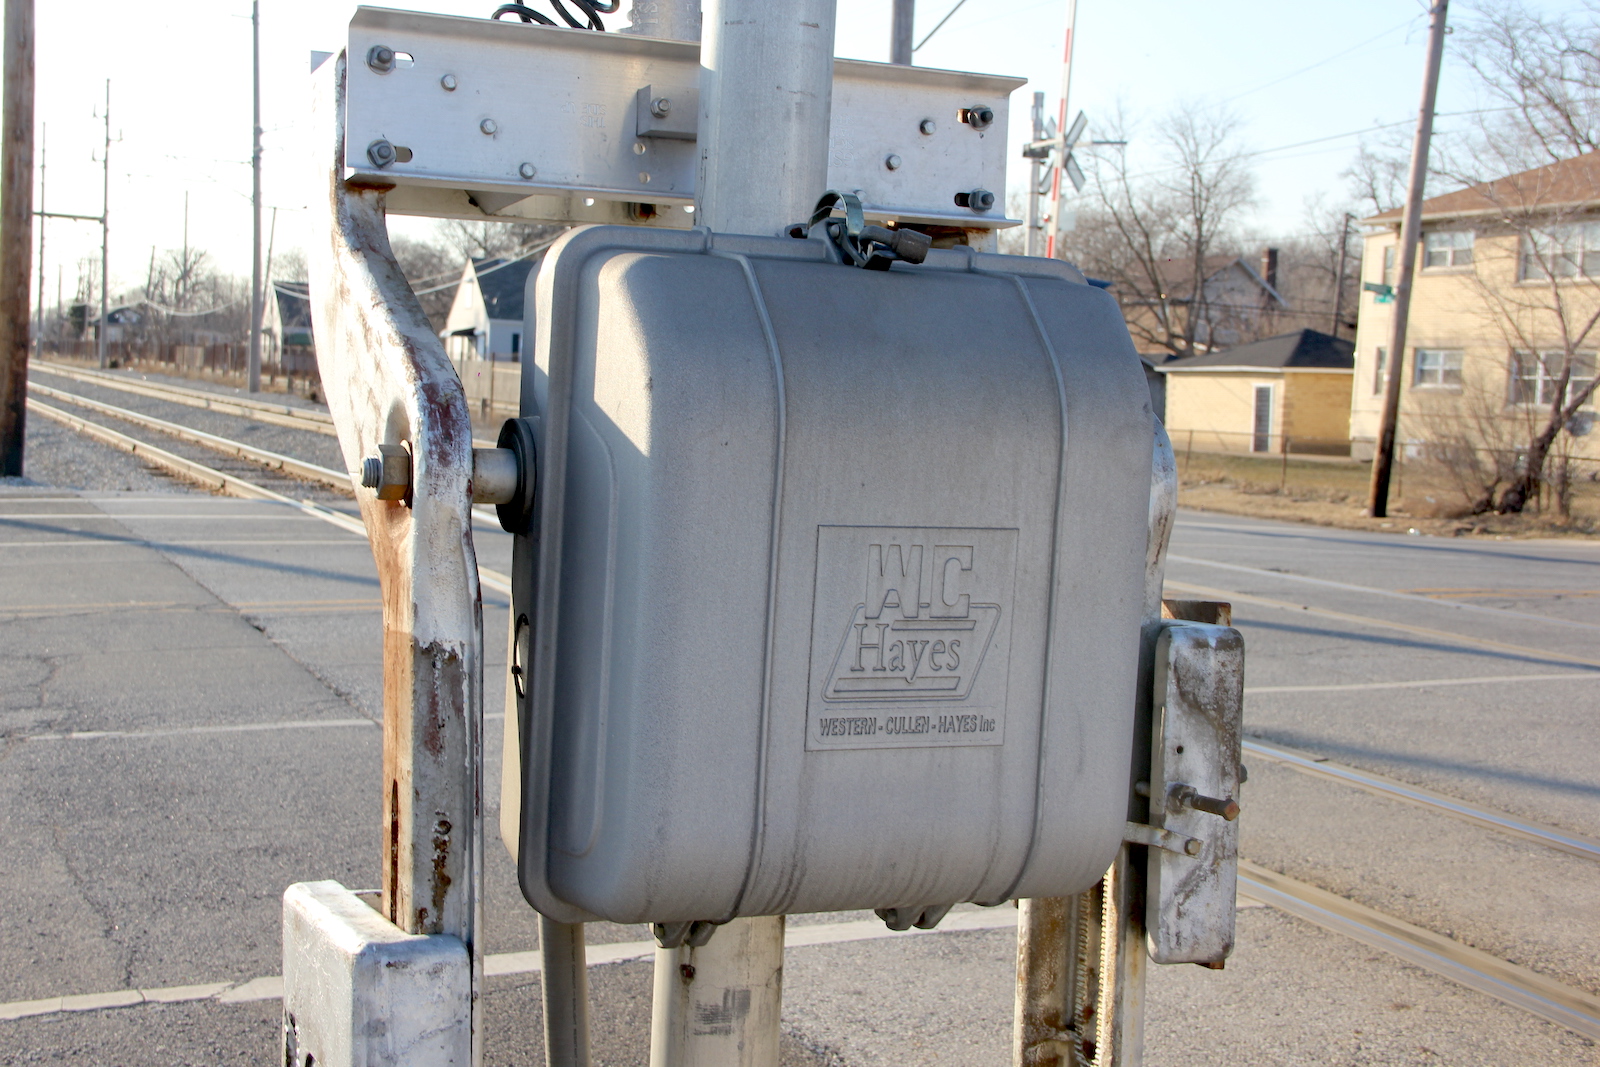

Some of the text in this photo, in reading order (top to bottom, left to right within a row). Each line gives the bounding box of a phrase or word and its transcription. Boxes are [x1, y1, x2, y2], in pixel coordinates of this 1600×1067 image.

[850, 623, 961, 682] Hayes
[819, 717, 877, 736] WESTERN
[885, 715, 930, 735] CULLEN
[938, 714, 978, 733] HAYES
[979, 714, 996, 732] Inc
